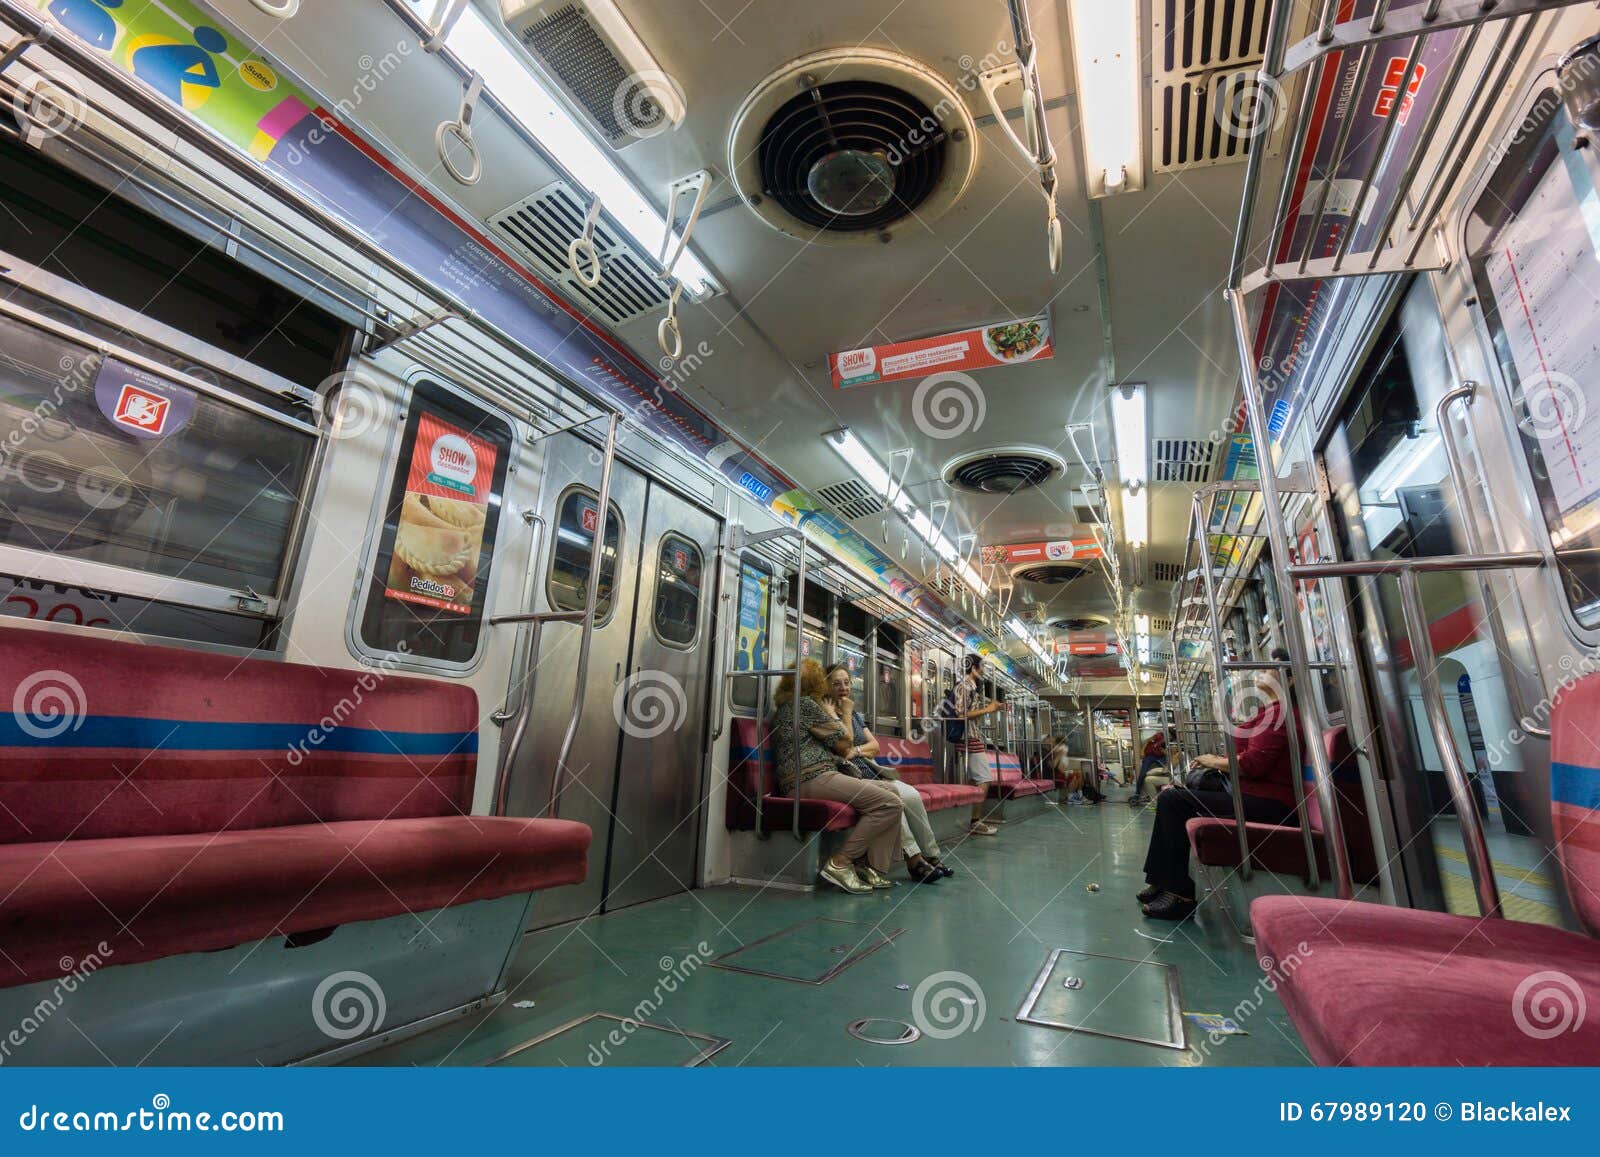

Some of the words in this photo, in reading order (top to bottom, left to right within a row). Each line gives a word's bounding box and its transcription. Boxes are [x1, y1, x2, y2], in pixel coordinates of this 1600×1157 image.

[1335, 59, 1359, 120] EMERGENCIAS
[465, 240, 499, 268] CUIDEMOS
[506, 271, 524, 287] SUBTE
[842, 351, 865, 367] SHOW
[440, 446, 468, 466] SHOW
[410, 576, 455, 598] PedidosYa
